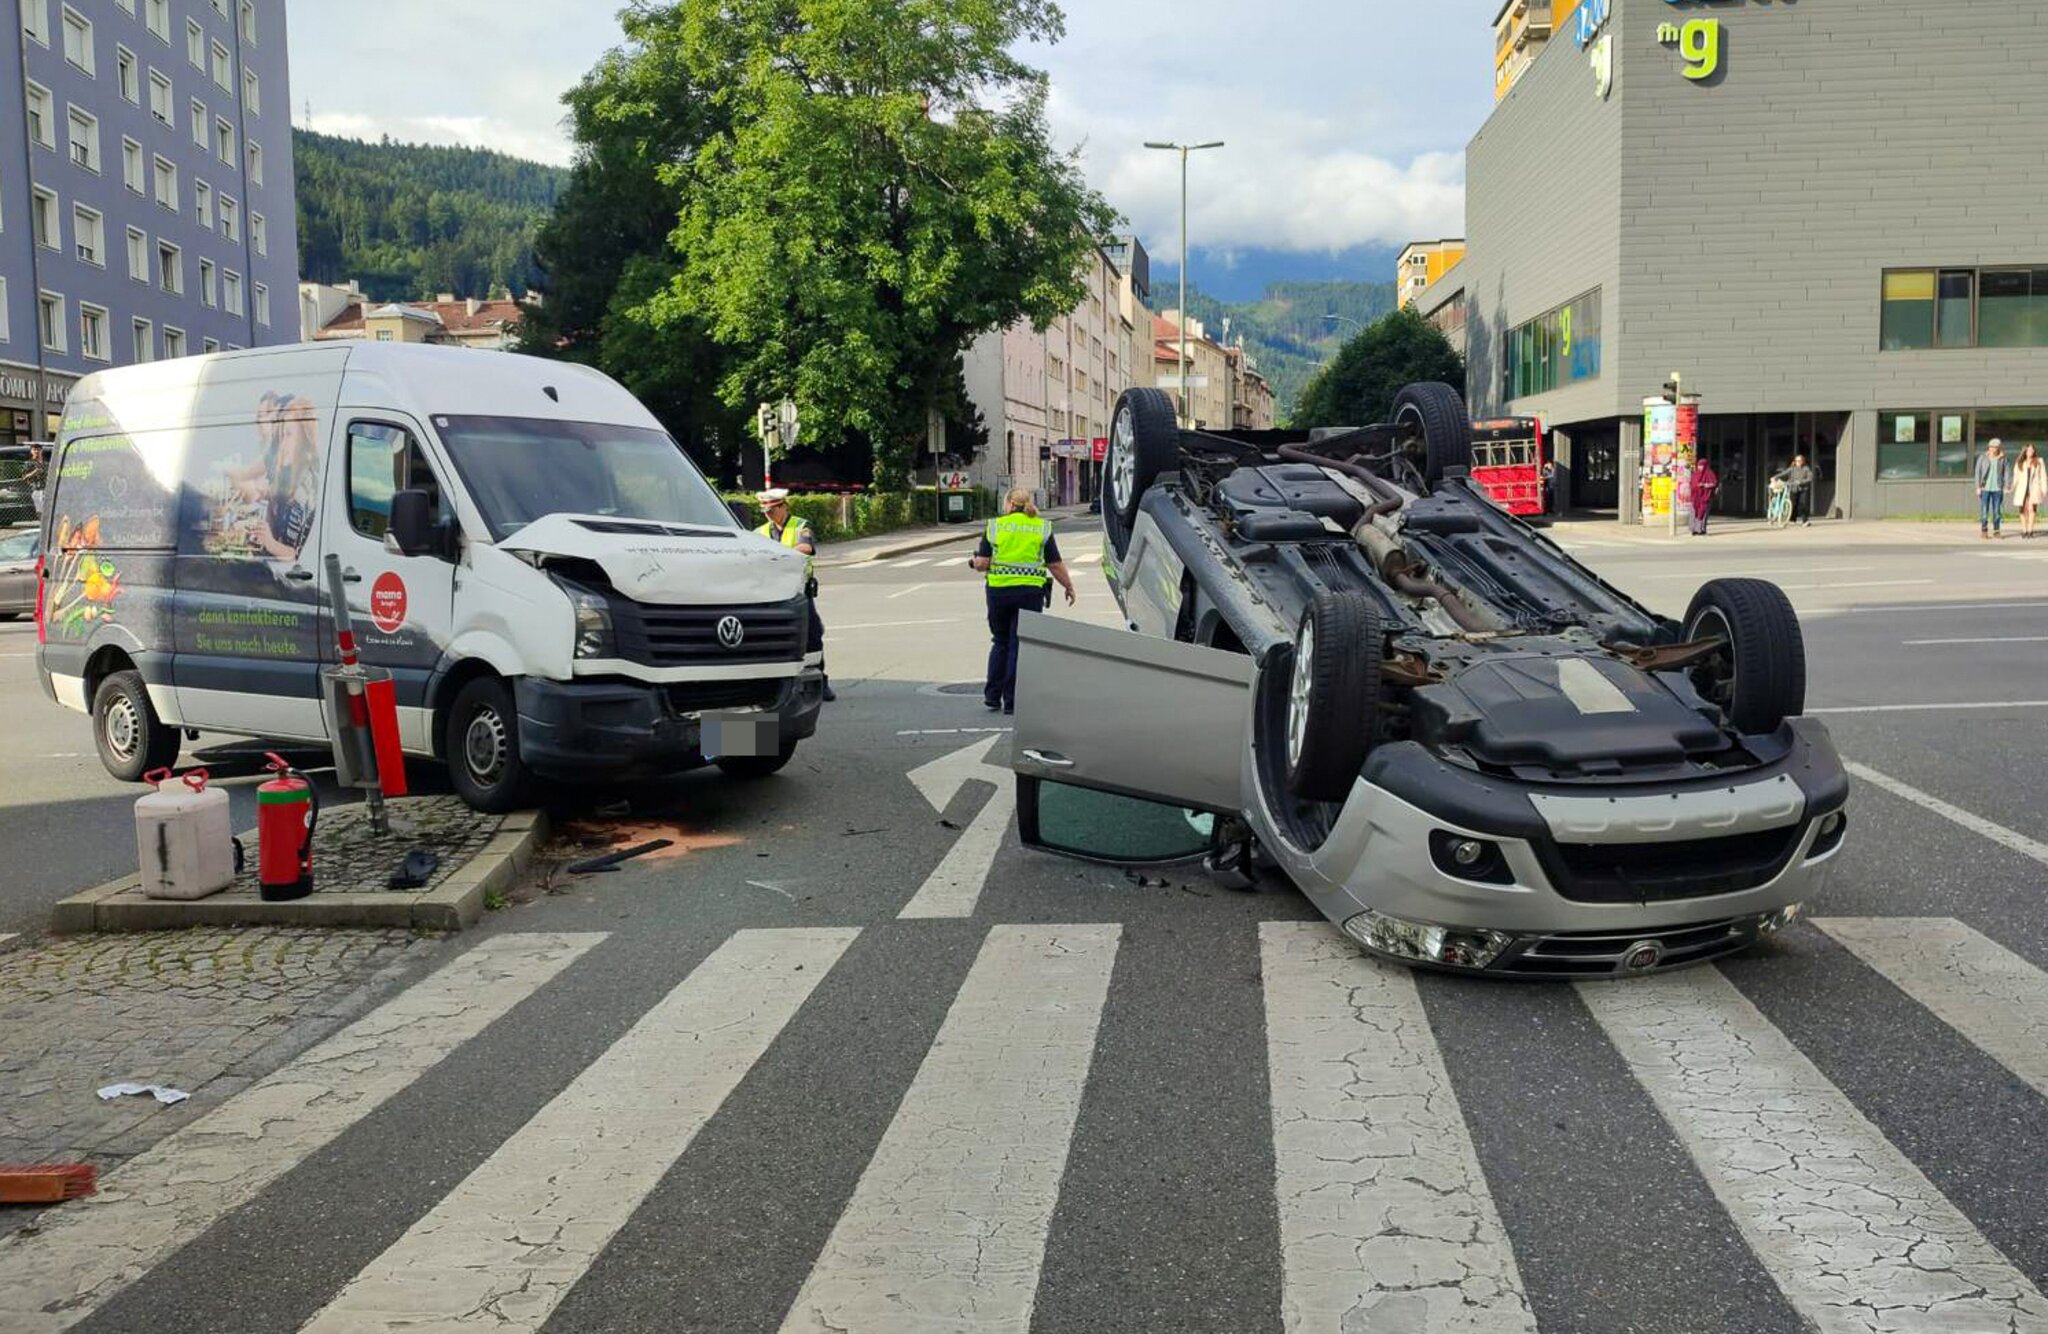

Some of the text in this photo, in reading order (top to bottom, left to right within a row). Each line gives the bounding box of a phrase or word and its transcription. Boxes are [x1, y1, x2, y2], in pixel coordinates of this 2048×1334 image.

[375, 590, 403, 600] mama
[199, 606, 299, 627] dann kontaktieren
[195, 632, 213, 650] Sie
[214, 639, 233, 651] uns
